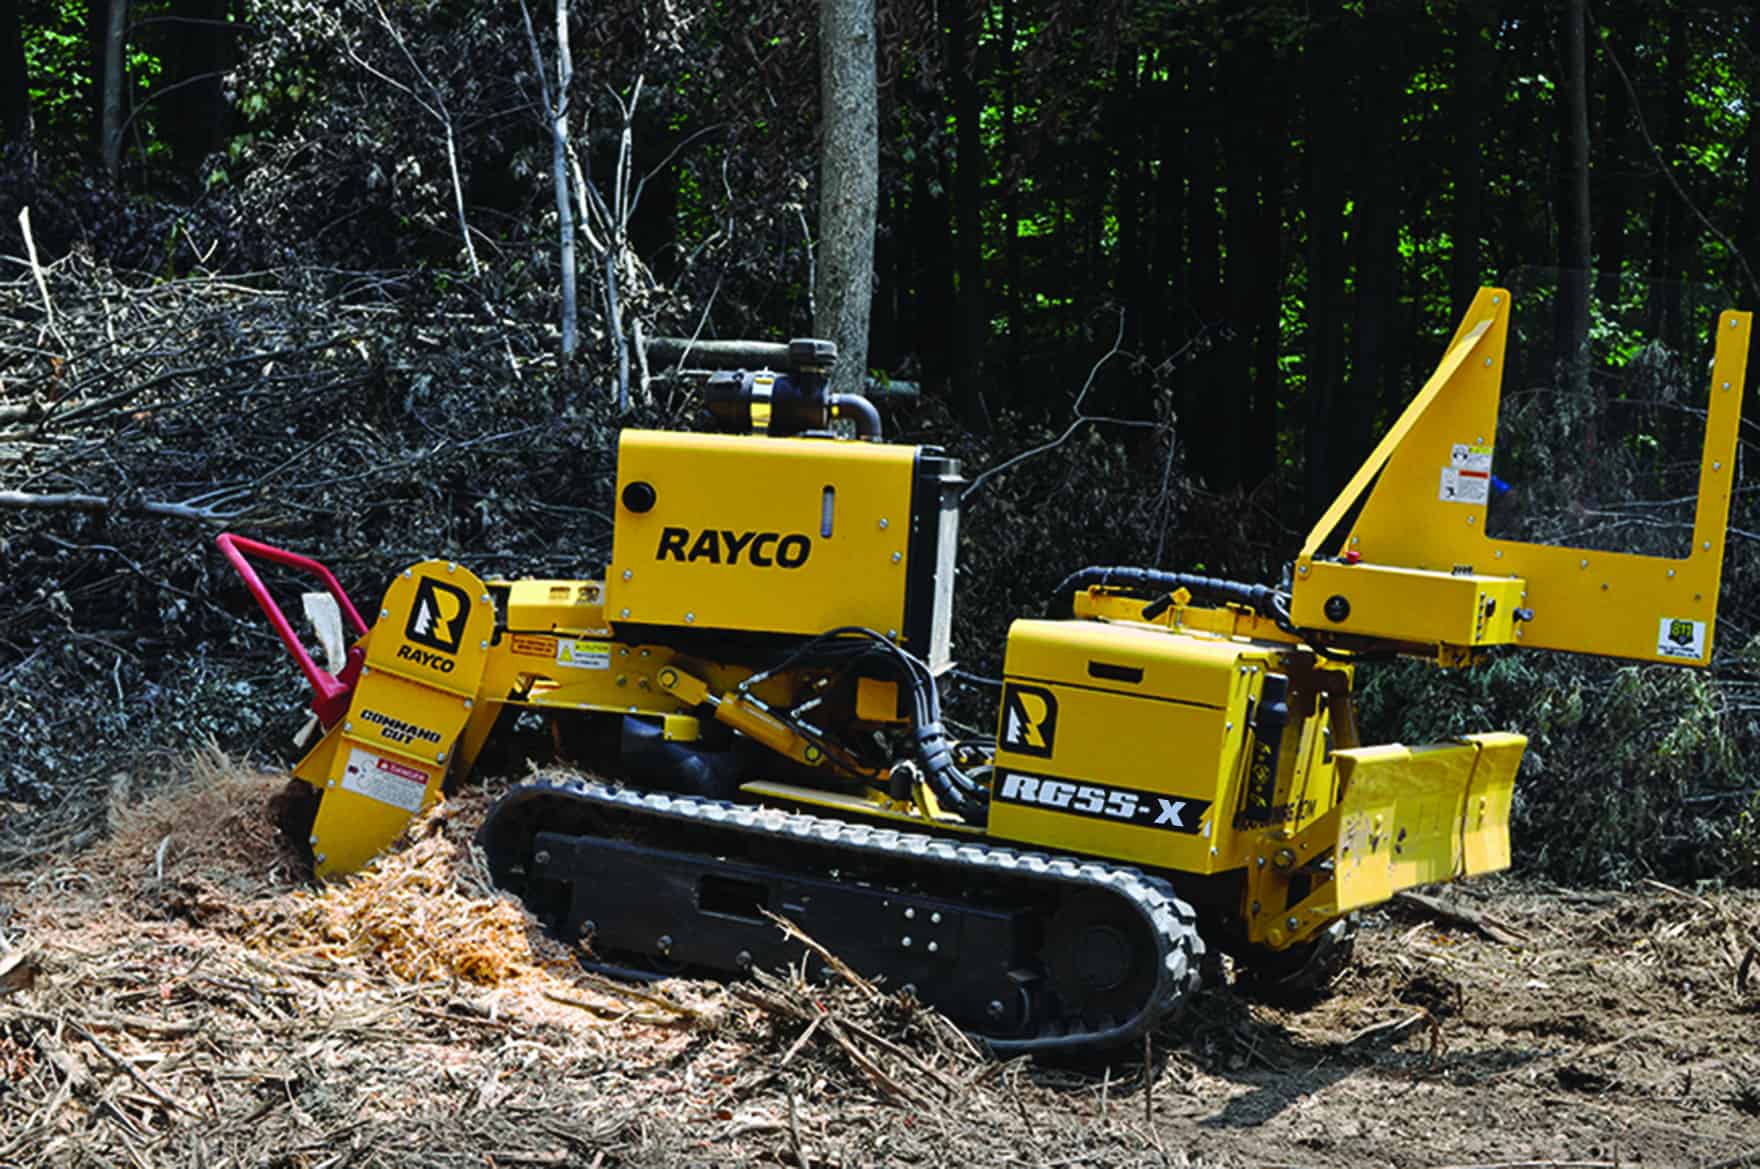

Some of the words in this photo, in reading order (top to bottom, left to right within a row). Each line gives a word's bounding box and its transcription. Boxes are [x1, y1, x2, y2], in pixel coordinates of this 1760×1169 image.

[656, 527, 812, 568] RAYCO
[397, 644, 455, 673] RAYCO
[360, 709, 441, 744] COMMAND
[381, 726, 413, 744] CUT
[1001, 773, 1187, 827] RG55-X
